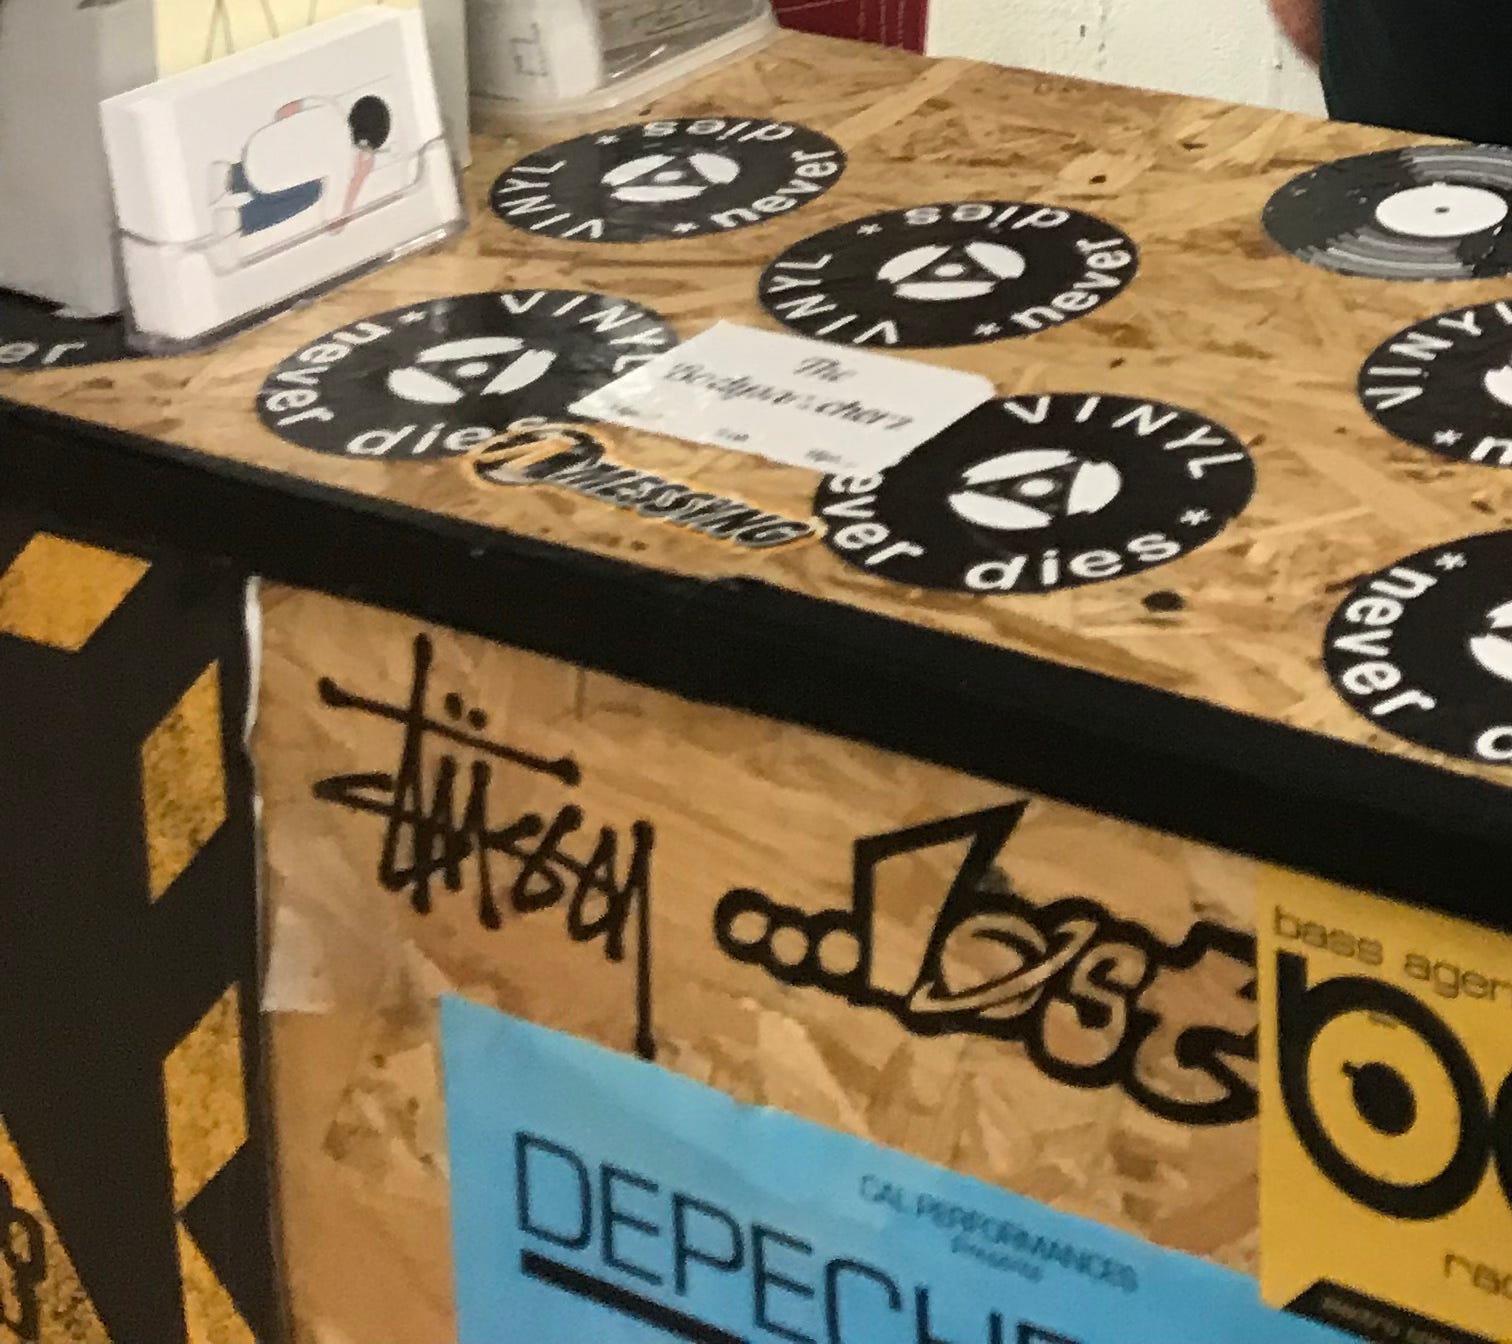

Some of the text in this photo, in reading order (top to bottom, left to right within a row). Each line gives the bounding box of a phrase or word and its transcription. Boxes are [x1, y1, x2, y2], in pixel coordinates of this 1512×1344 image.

[499, 119, 840, 242] VINYL never dies
[766, 206, 1125, 346] VINYL never dies
[264, 322, 392, 429] never
[820, 396, 1244, 591] VINYL ever dies
[1334, 565, 1437, 717] never
[1273, 904, 1384, 967] bass
